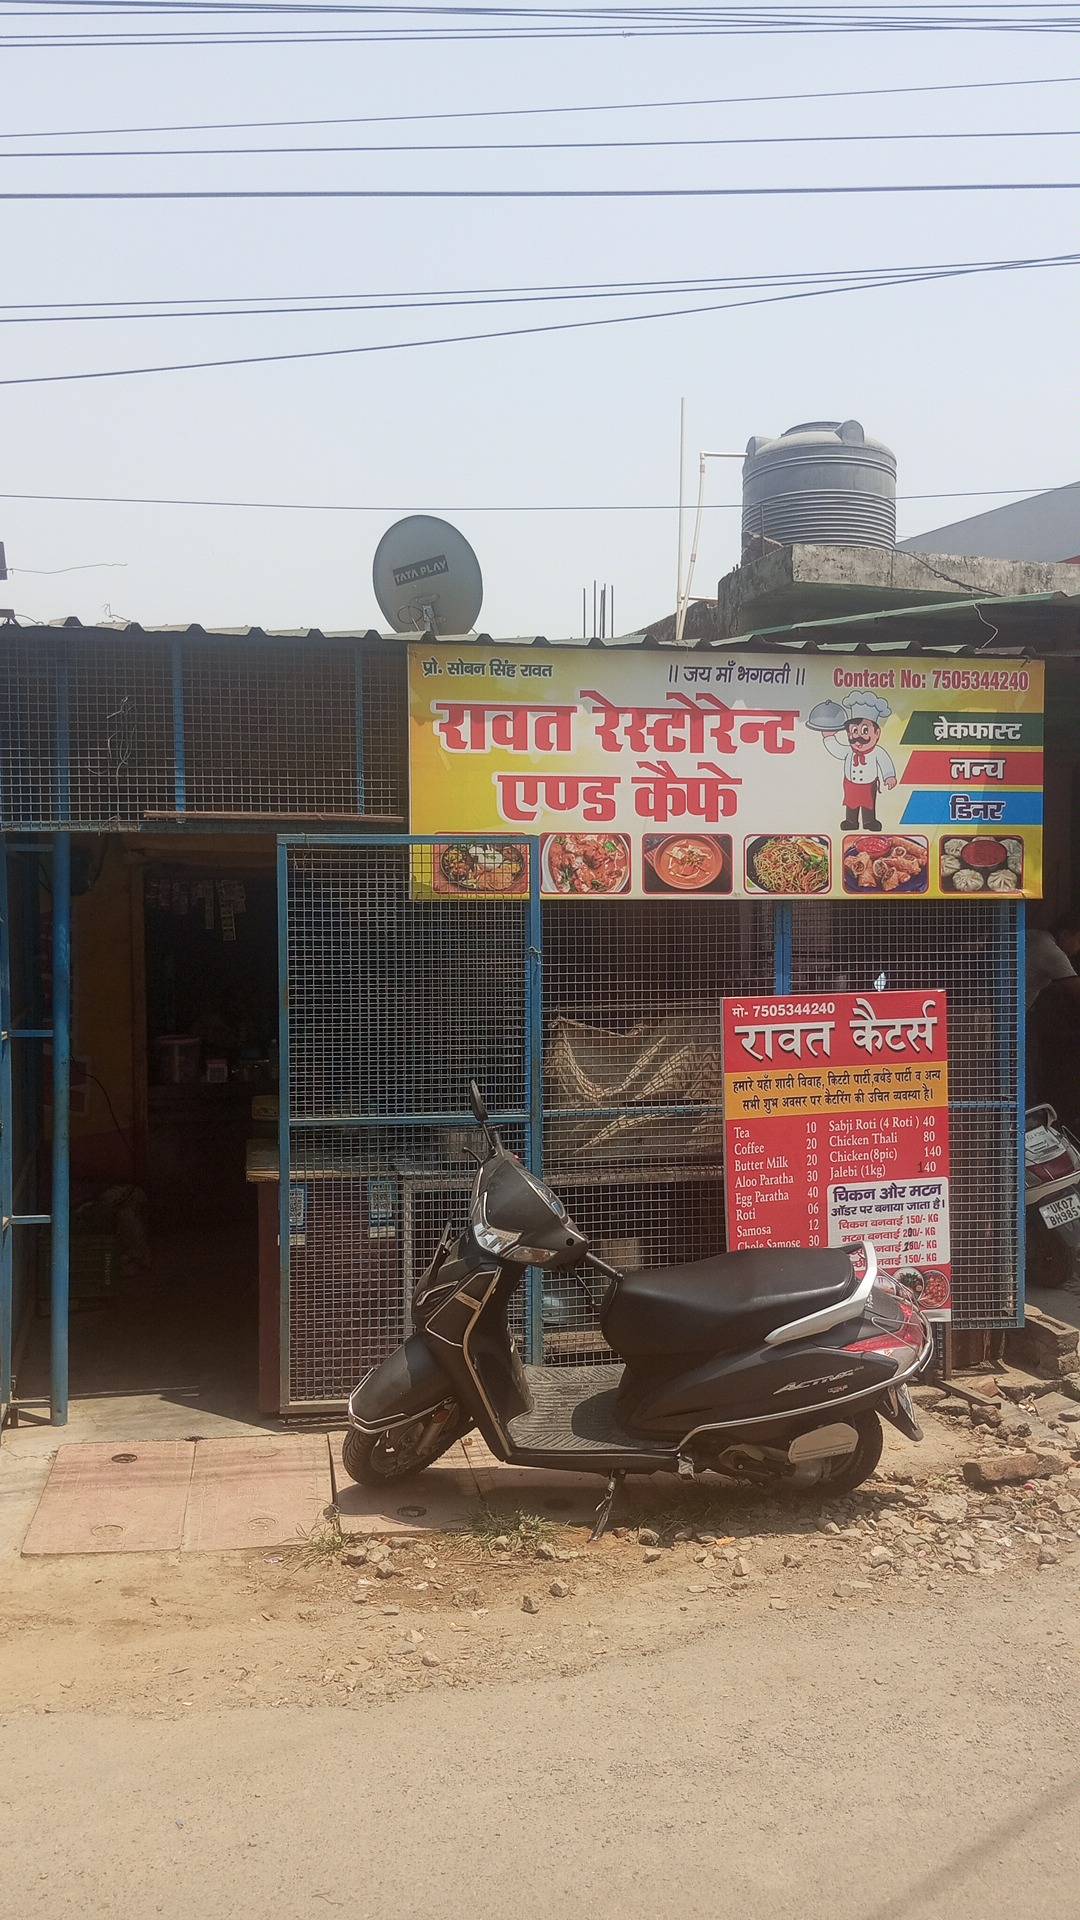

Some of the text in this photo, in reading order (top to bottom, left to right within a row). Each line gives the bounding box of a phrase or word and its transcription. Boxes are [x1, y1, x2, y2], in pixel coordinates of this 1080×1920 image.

[395, 560, 446, 583] TATA PLAY
[447, 658, 485, 676] सोबन
[489, 659, 516, 677] सिंह
[521, 664, 552, 677] रावत
[683, 666, 711, 683] जय
[715, 660, 733, 683] माँ
[737, 663, 791, 684] भगवती
[833, 668, 1029, 691] Contact No: 7505344240
[435, 690, 800, 754] रावत रेस्टोरेन्ट
[933, 716, 1023, 741] ब्रेकफास्ट
[949, 758, 1006, 780] लन्च
[497, 761, 743, 823] एण्ड कैफे
[949, 794, 1006, 821] डिनर
[753, 1002, 835, 1018] 7505344240
[734, 998, 938, 1061] रावत कैटर्स
[732, 1077, 754, 1093] हमारे
[757, 1074, 772, 1091] यहाँ
[775, 1073, 794, 1089] शादी
[895, 1067, 912, 1082] पार्टी
[915, 1071, 921, 1080] व
[925, 1070, 941, 1080] अन्य
[743, 1095, 760, 1111] सभी
[763, 1098, 779, 1114] शुभ
[782, 1096, 807, 1108] अवसर
[810, 1095, 822, 1105] पर
[854, 1089, 865, 1103] की
[868, 1088, 890, 1103] उचित
[893, 1090, 920, 1101] व्यवस्था
[734, 1122, 817, 1138] Tea 10
[829, 1119, 854, 1133] Sabji
[855, 1118, 877, 1130] Roti
[892, 1116, 914, 1129] Roti
[923, 1115, 935, 1127] 40
[734, 1138, 817, 1155] Coffee 20
[829, 1131, 935, 1147] Chicken Thali 80
[735, 1155, 818, 1172] Butter Milk 20
[829, 1146, 942, 1163] Chicken(8pic) 140
[735, 1170, 818, 1189] Aloo Paratha 30
[829, 1166, 857, 1181] Jalebi
[861, 1164, 886, 1178] (1kg)
[735, 1186, 819, 1208] Egg Paratha 40
[833, 1183, 942, 1202] चिकन और मटन
[736, 1203, 819, 1221] Roti 06
[860, 1205, 873, 1214] पर
[906, 1201, 930, 1211] जाता
[1049, 1197, 1073, 1214] UK07
[838, 1219, 868, 1230] चिकन
[906, 1215, 926, 1225] 150/-
[928, 1213, 939, 1223] KG
[1049, 1205, 1080, 1226] BH985
[737, 1219, 819, 1238] Samosa 12
[841, 1233, 865, 1243] मटन
[925, 1226, 936, 1236] KG
[808, 1234, 820, 1247] 30
[874, 1241, 902, 1253] नवाई
[926, 1240, 937, 1250] KG
[905, 1254, 926, 1264] 150/-
[927, 1253, 938, 1262] KG
